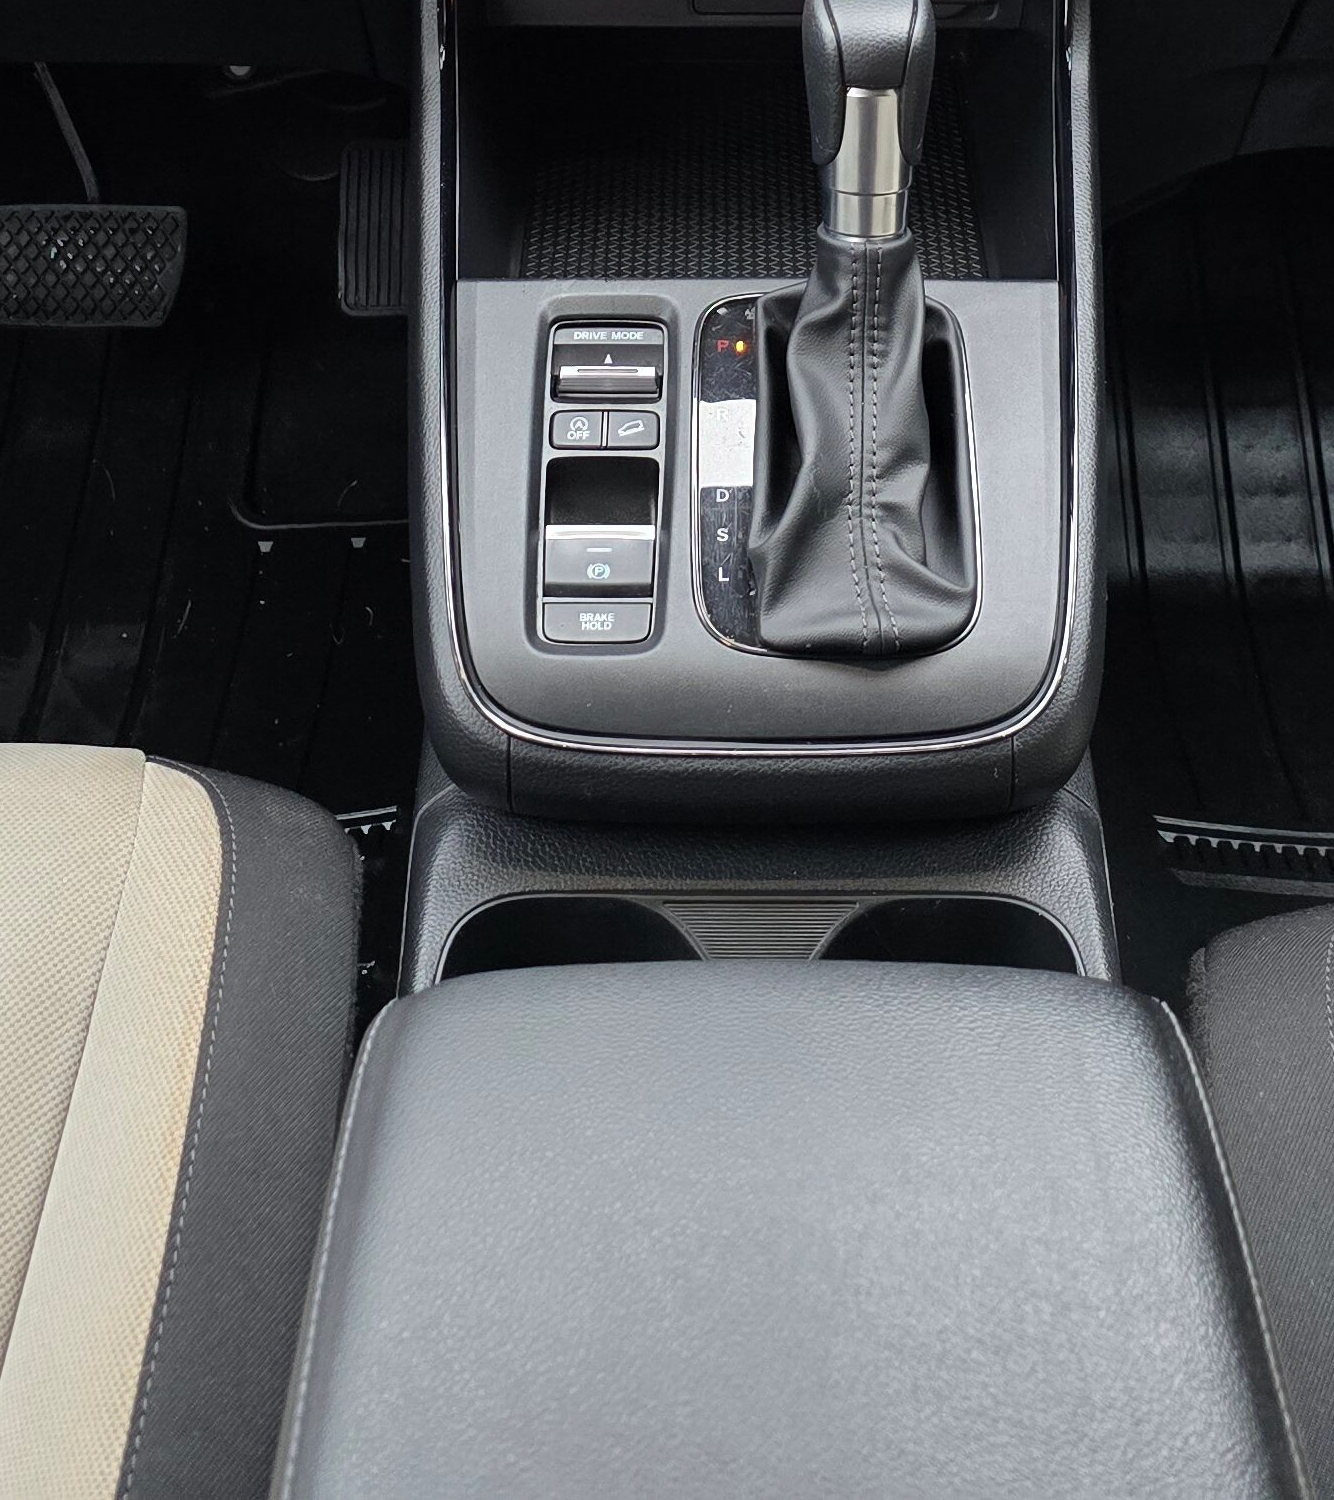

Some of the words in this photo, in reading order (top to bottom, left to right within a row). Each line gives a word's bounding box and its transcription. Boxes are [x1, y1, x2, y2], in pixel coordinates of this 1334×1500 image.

[573, 330, 607, 341] DRIVE
[611, 330, 644, 341] MODE
[717, 340, 729, 352] P
[567, 430, 590, 441] OFF
[716, 489, 729, 502] D
[716, 528, 729, 541] S
[718, 568, 729, 581] L
[579, 612, 615, 623] BRAKE
[581, 621, 613, 631] HOLD
